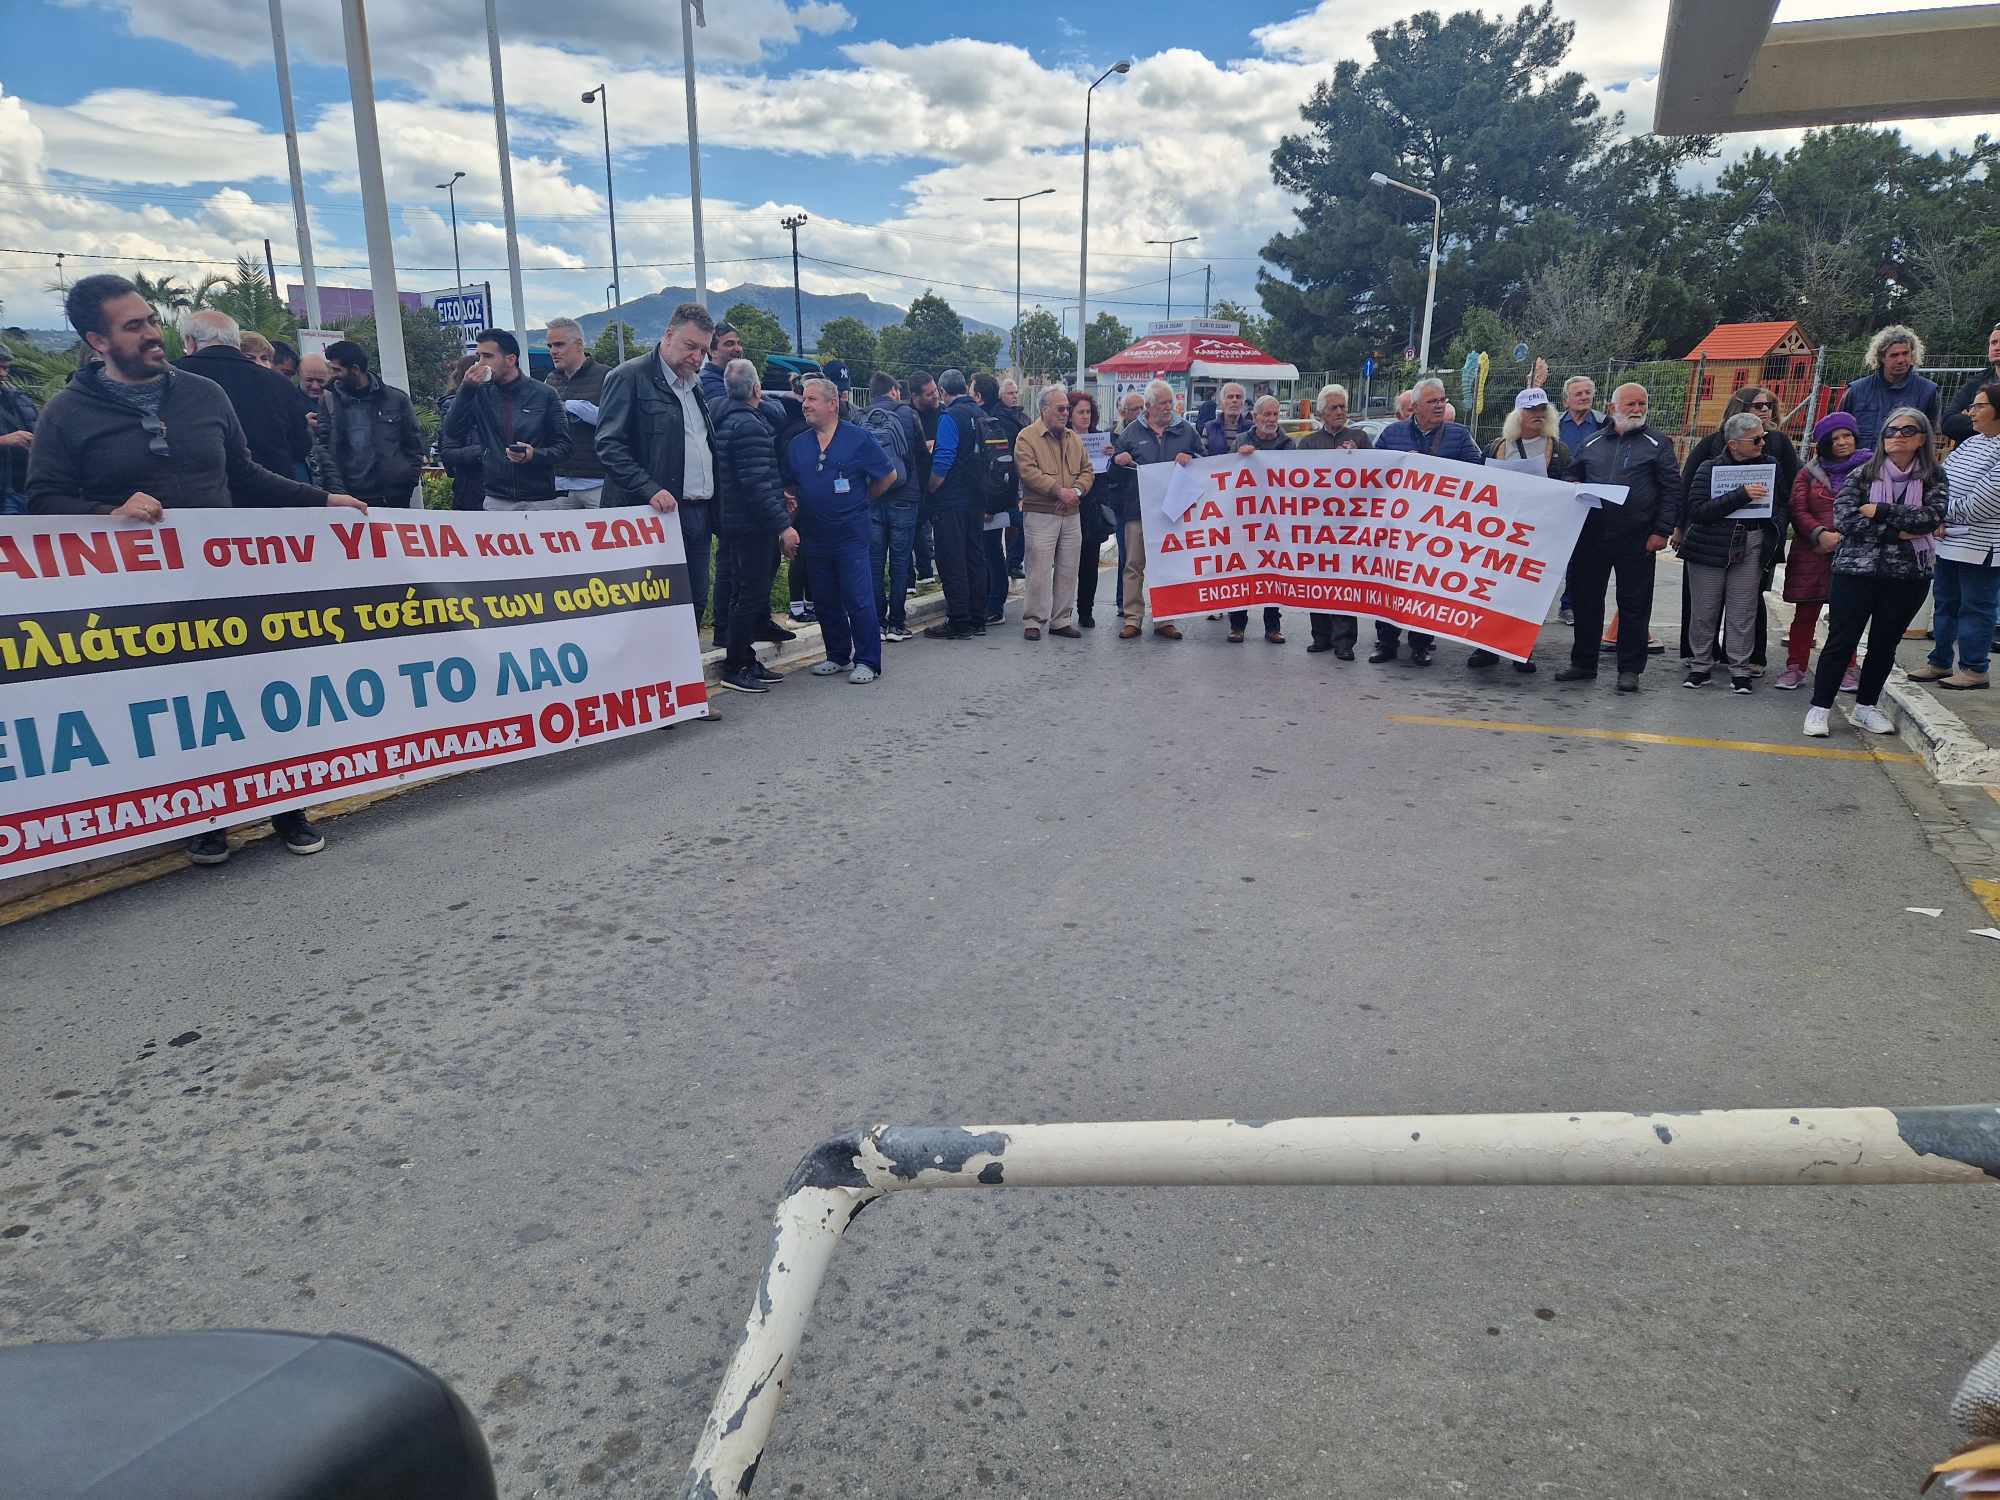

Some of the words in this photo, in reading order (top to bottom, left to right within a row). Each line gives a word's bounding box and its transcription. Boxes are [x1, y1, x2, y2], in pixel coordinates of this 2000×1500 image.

[1210, 468, 1257, 491] ΤΑ
[1266, 468, 1498, 507] ΝΟΣΟΚΟΜΕΙΑ
[203, 534, 315, 568] στην
[329, 522, 469, 560] ΥΓΕΙΑ
[475, 529, 535, 557] και
[540, 526, 581, 553] τη
[585, 516, 667, 550] ΖΩΗ
[1419, 505, 1536, 547] ΛΑΟΣ
[1160, 526, 1231, 553] ΔΕΝ
[1242, 522, 1281, 543] ΤΑ
[1291, 525, 1546, 584] ΠΑΖΑΡΕΥΟΥΜΕ
[1193, 552, 1247, 576] ΓΙΑ
[1257, 550, 1340, 573] ΧΑΡΗ
[1352, 554, 1497, 602] ΚΑΝΕΝΟΣ
[260, 606, 346, 643] στις
[353, 586, 480, 632] τσέπες
[484, 590, 545, 621] των
[553, 569, 671, 613] ασθενών
[1199, 582, 1250, 603] ΕΝΩΣΗ
[1255, 580, 1361, 602] ΣΥΝΤΑΞΙΟΥΧΩΝ
[1366, 588, 1382, 606] ΙΚΑ
[1392, 596, 1484, 630] ΗΡΑΚΛΕΙΟΥ
[128, 690, 246, 759] ΓΙΑ
[260, 668, 385, 733] ΟΛΟ
[398, 656, 477, 709] ΤΟ
[496, 642, 589, 697] ΛΑΟ
[233, 750, 379, 804] ΓΙΑΤΡΩΝ
[384, 723, 523, 770] ΕΛΛΑΔΑΣ
[538, 680, 676, 744] ΟΕΝΓΕ
